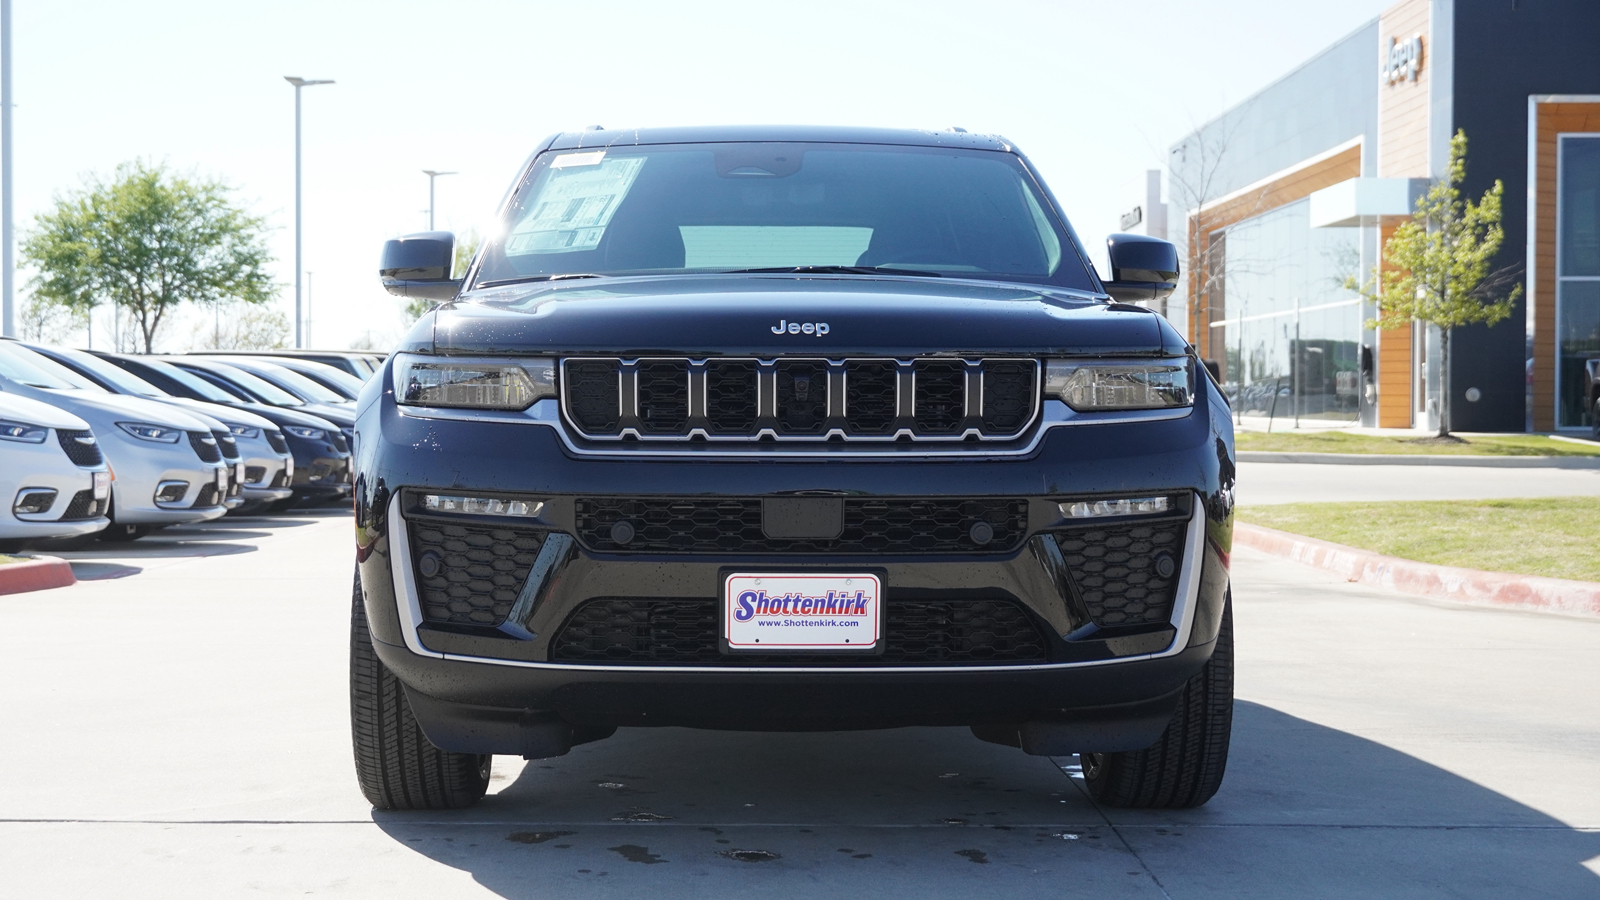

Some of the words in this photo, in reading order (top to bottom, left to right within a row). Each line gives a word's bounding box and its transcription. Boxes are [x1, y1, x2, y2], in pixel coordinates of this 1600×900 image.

[1382, 33, 1423, 84] Jeep
[771, 319, 830, 337] Jeep
[735, 590, 869, 621] Shottenkirk
[758, 619, 859, 627] www.Shottenkirk.com
